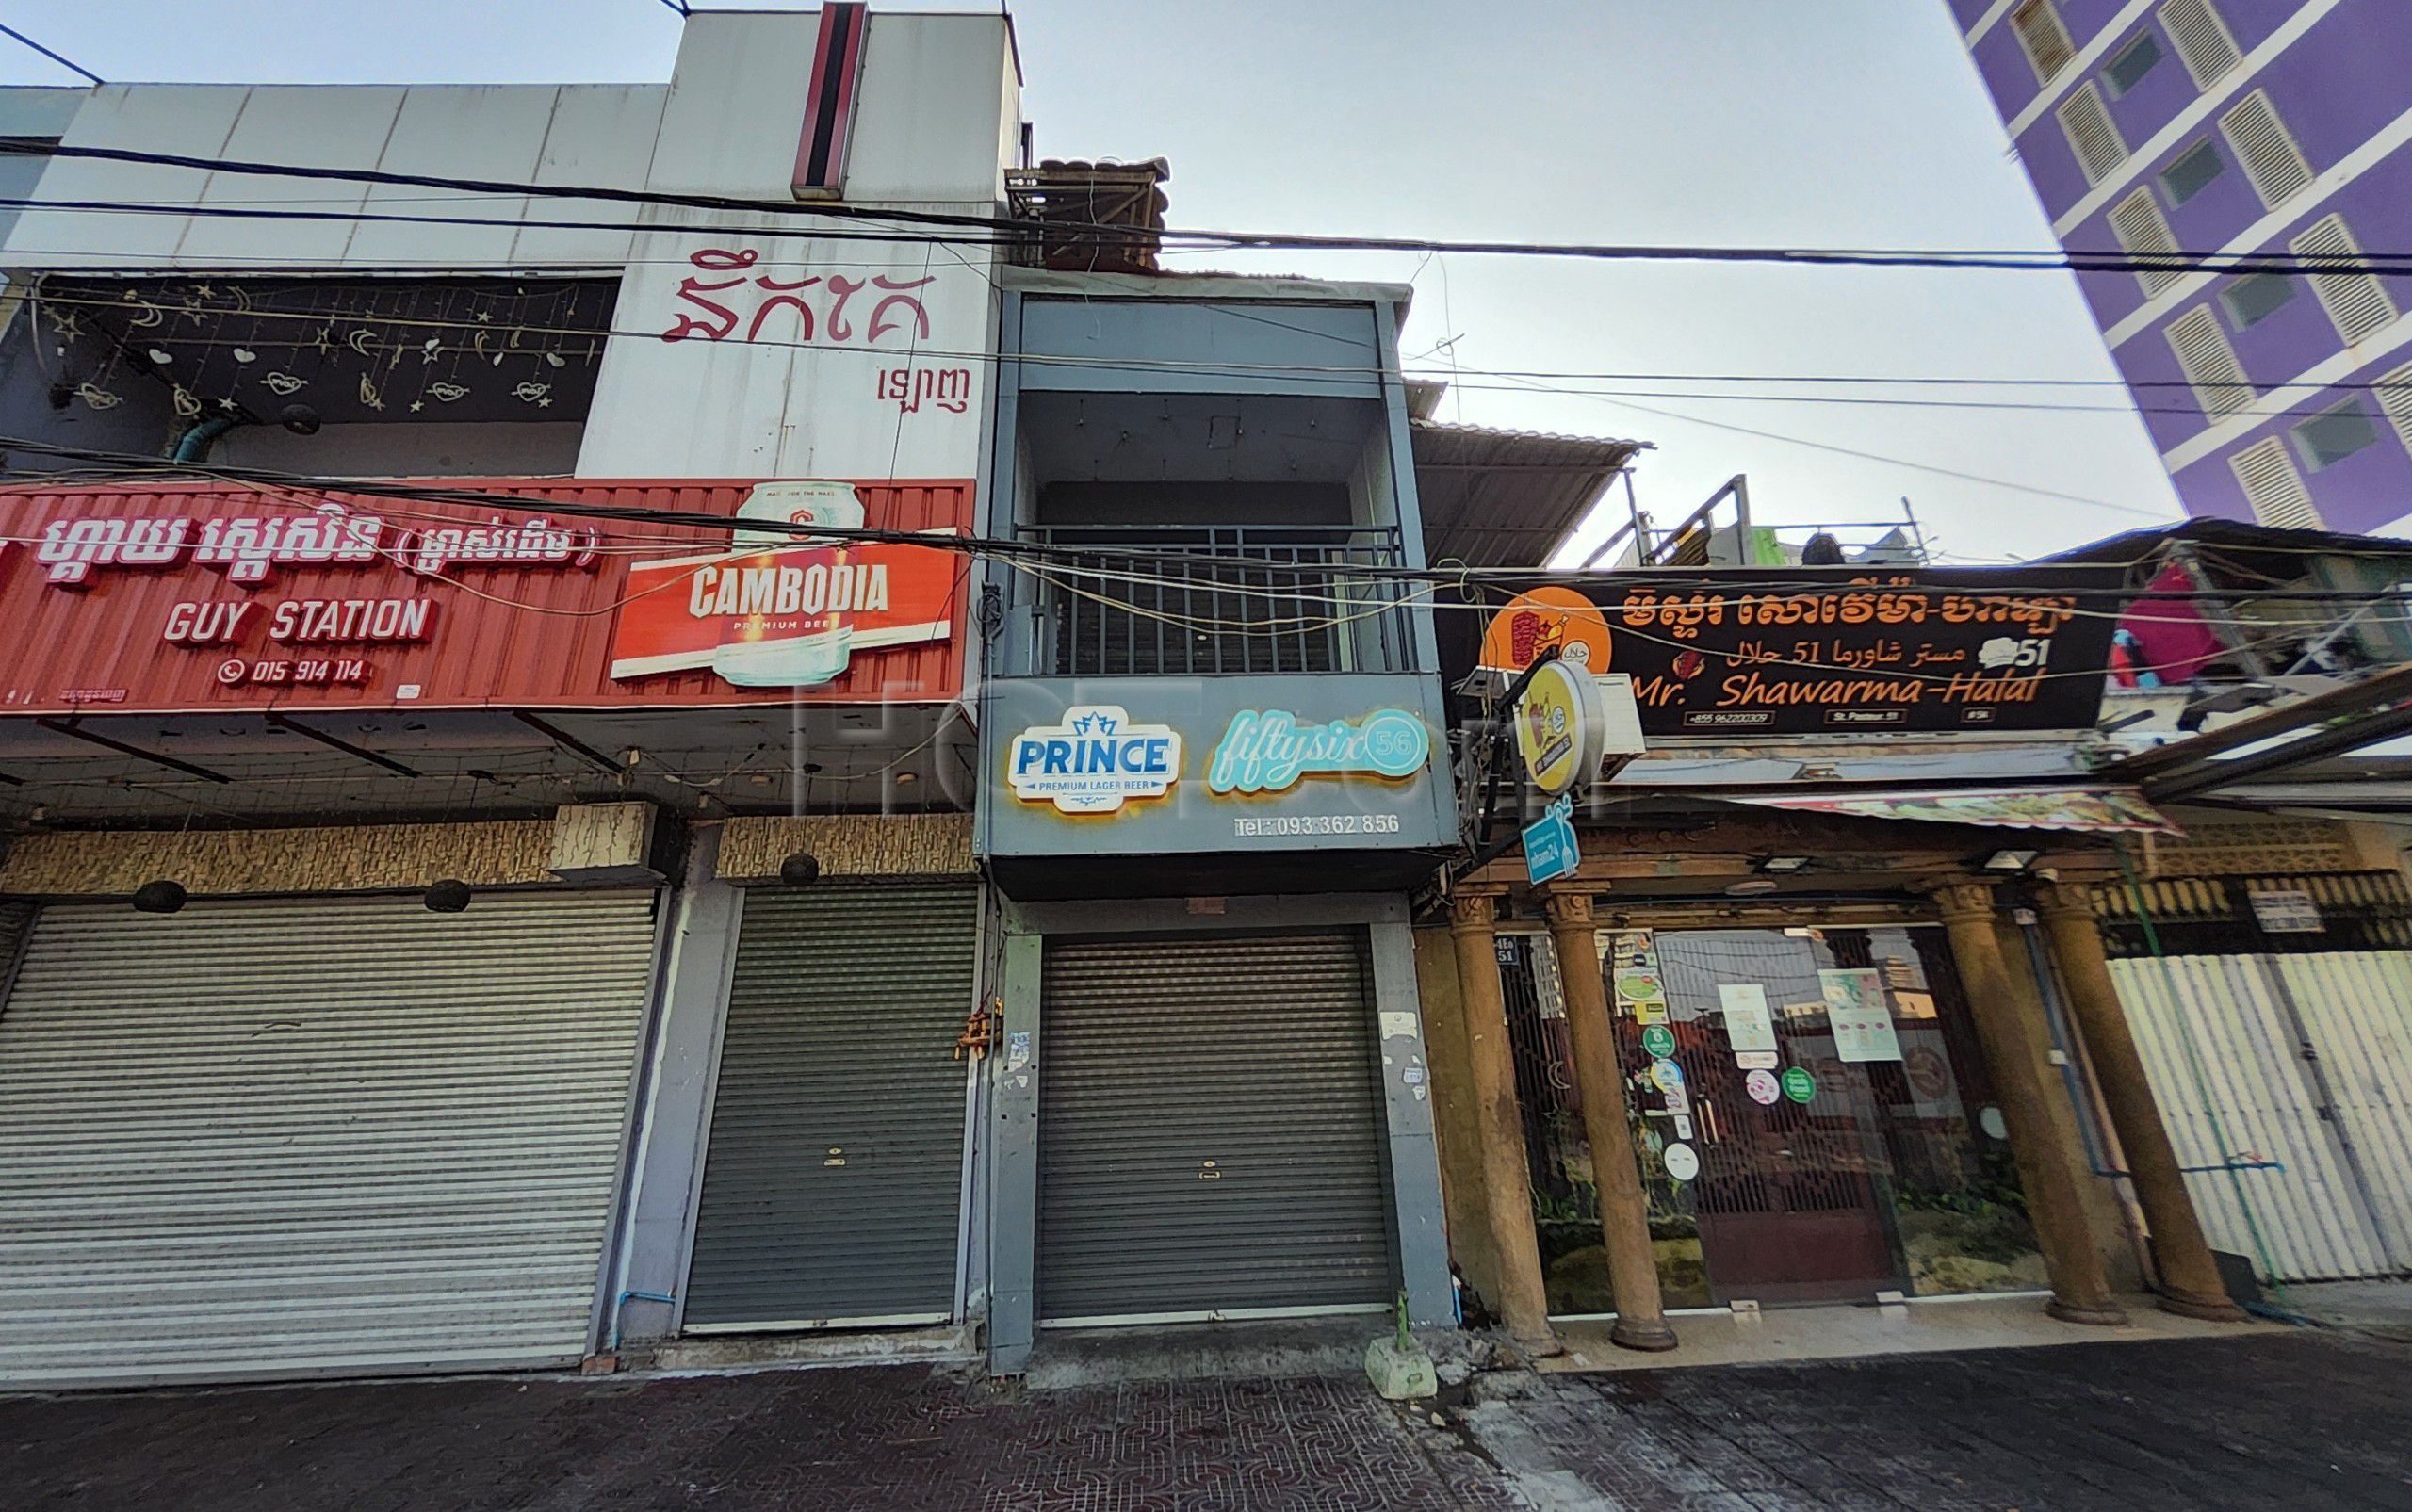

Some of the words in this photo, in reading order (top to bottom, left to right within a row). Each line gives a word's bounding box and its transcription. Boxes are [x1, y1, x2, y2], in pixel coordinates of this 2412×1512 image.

[689, 563, 888, 618] CAMBODIA
[164, 601, 256, 641] GUY
[270, 599, 431, 641] STATION
[734, 621, 797, 629] PRMIUM
[1793, 642, 1819, 663] 51
[1832, 640, 1903, 669] شاورما
[1909, 641, 1966, 667] مستر
[2013, 639, 2051, 667] 51
[253, 661, 285, 681] 015
[295, 660, 328, 680] 914
[334, 660, 364, 680] 114
[1632, 675, 1686, 707] Mr.
[1017, 738, 1170, 774] PRINCE
[1217, 714, 1368, 786] fiftysix
[1376, 730, 1412, 756] 56
[1039, 781, 1087, 790] PREMIUM
[1090, 781, 1121, 789] LAGER
[1124, 780, 1149, 789] BEER
[1277, 817, 1312, 835] 093
[1319, 816, 1357, 835] 362
[1362, 815, 1400, 834] 856
[1498, 951, 1513, 961] 51
